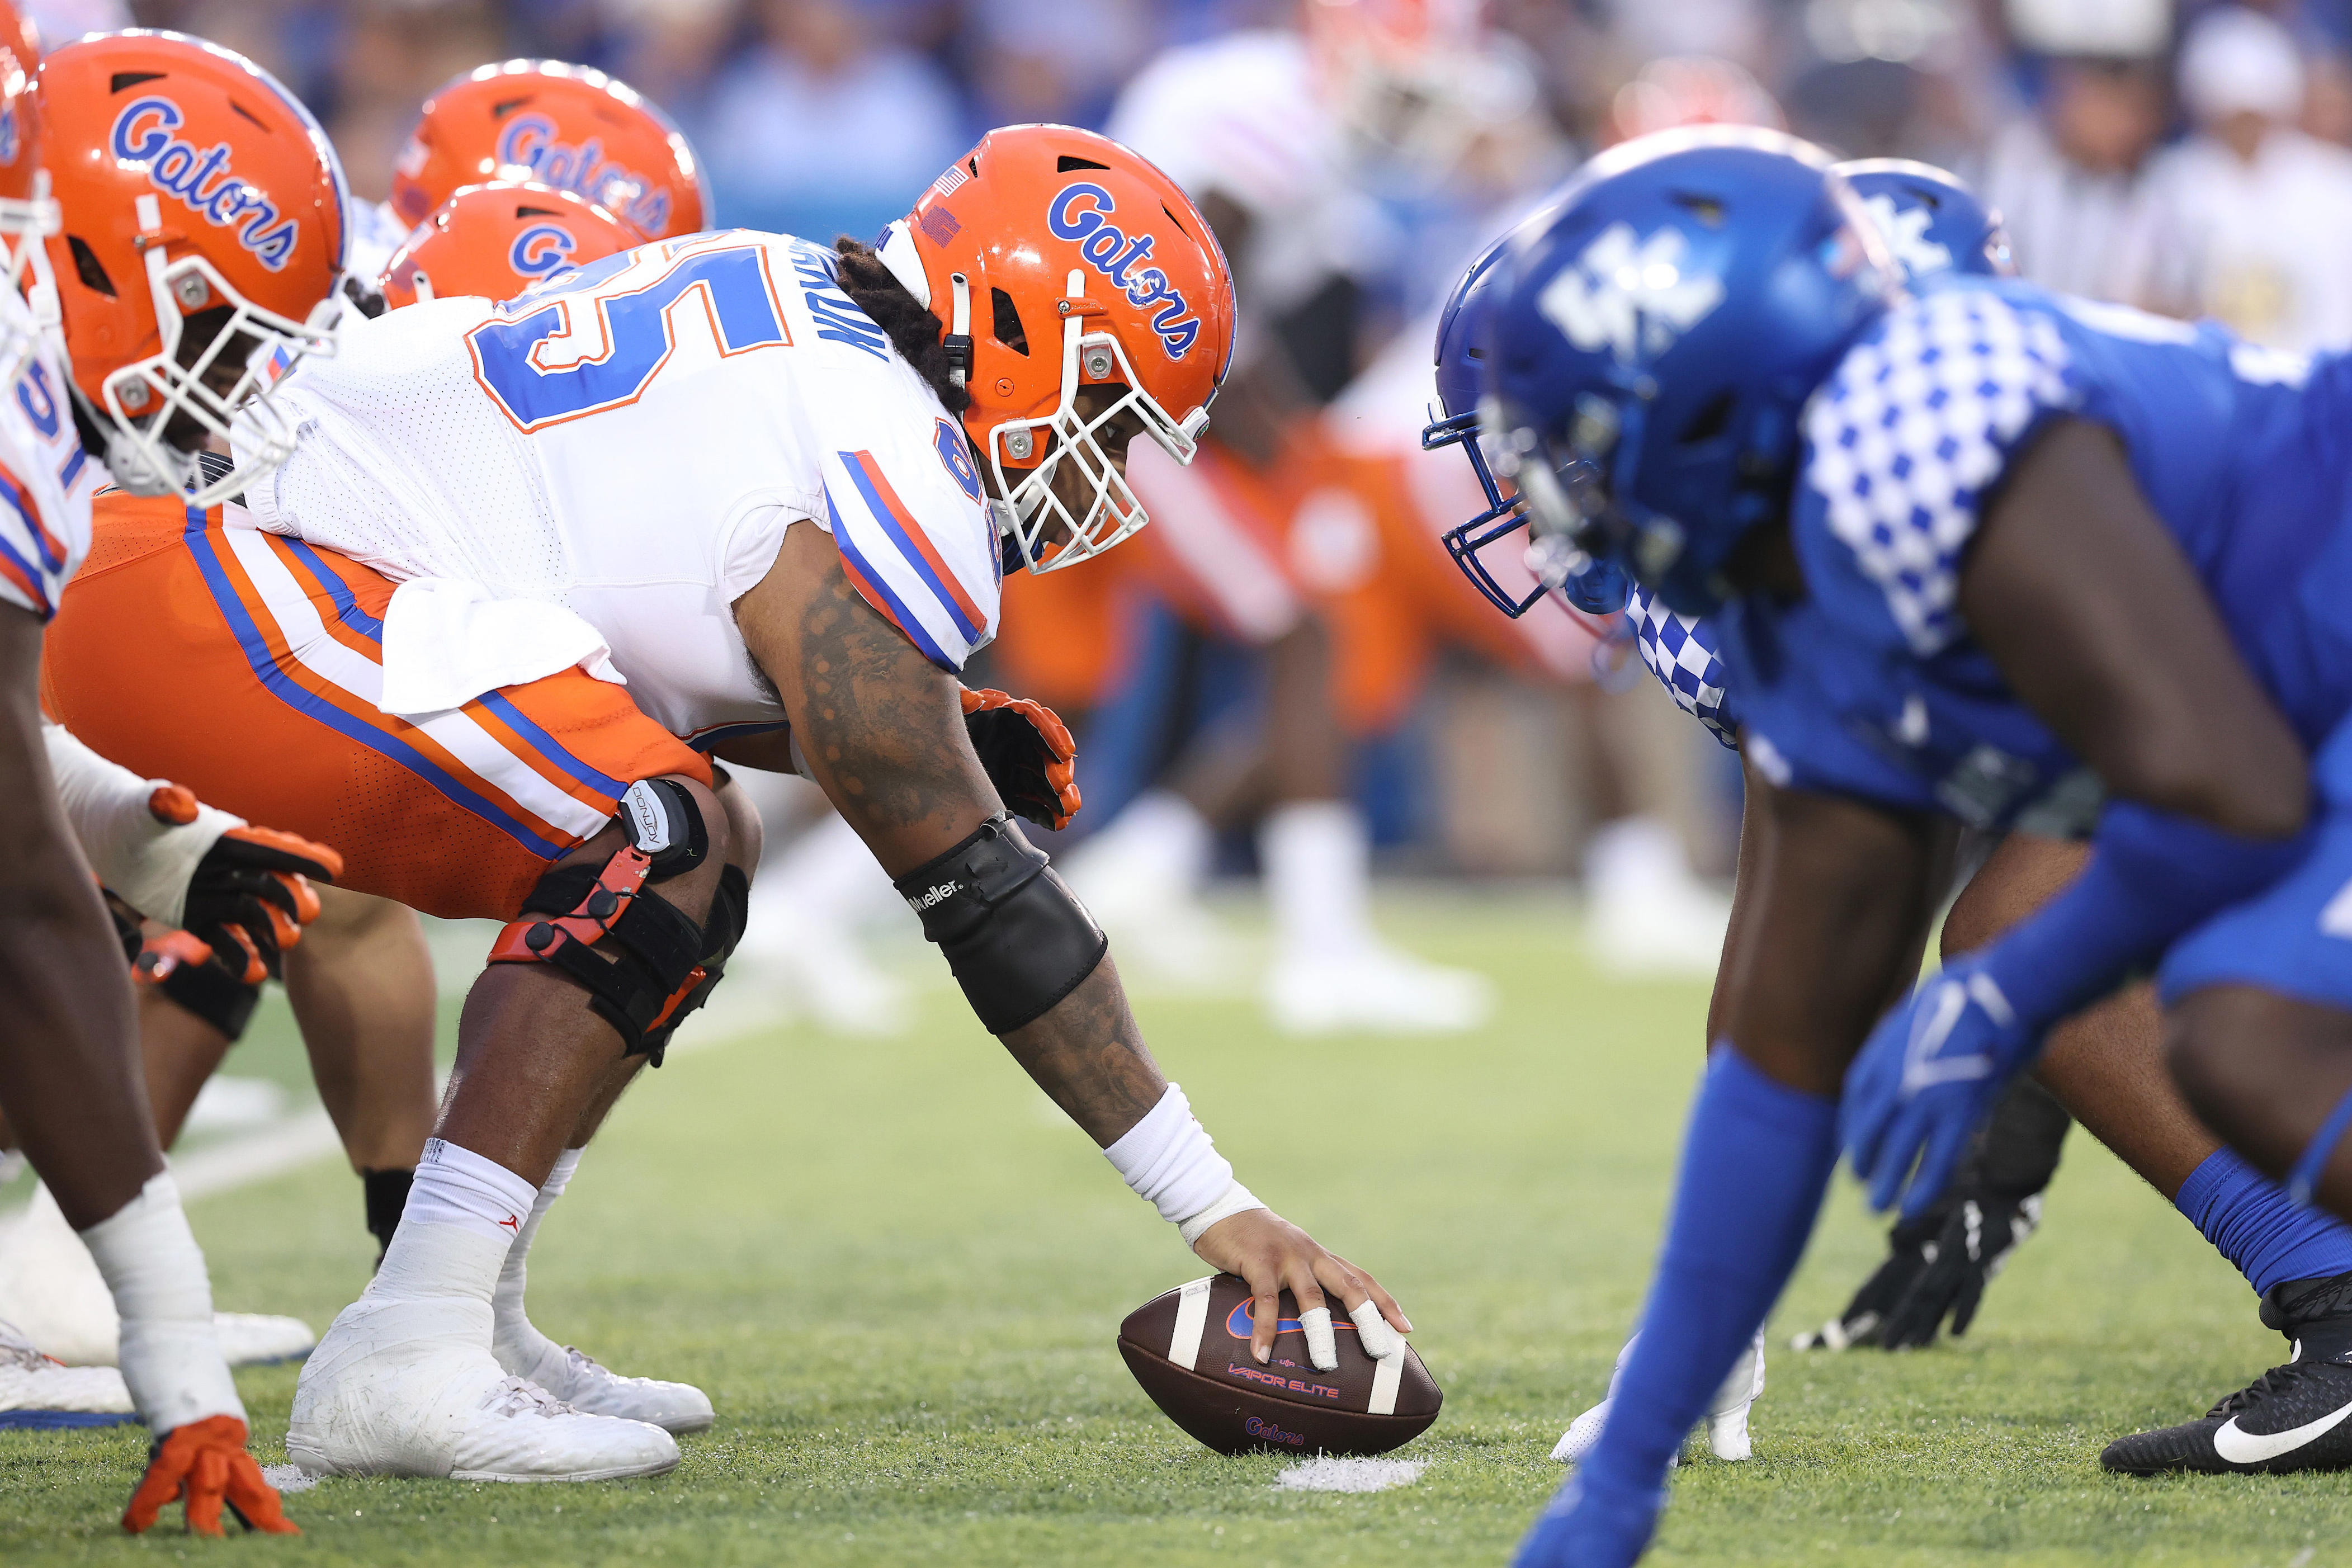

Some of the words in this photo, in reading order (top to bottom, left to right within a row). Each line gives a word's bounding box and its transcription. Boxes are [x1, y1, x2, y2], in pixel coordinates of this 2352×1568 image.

[109, 95, 300, 273] Gators
[495, 112, 673, 239] Gators
[1047, 182, 1204, 362] Gators
[1227, 1362, 1286, 1388] VAPOR
[1288, 1380, 1340, 1399] ELITE
[1245, 1416, 1304, 1446] Gators
